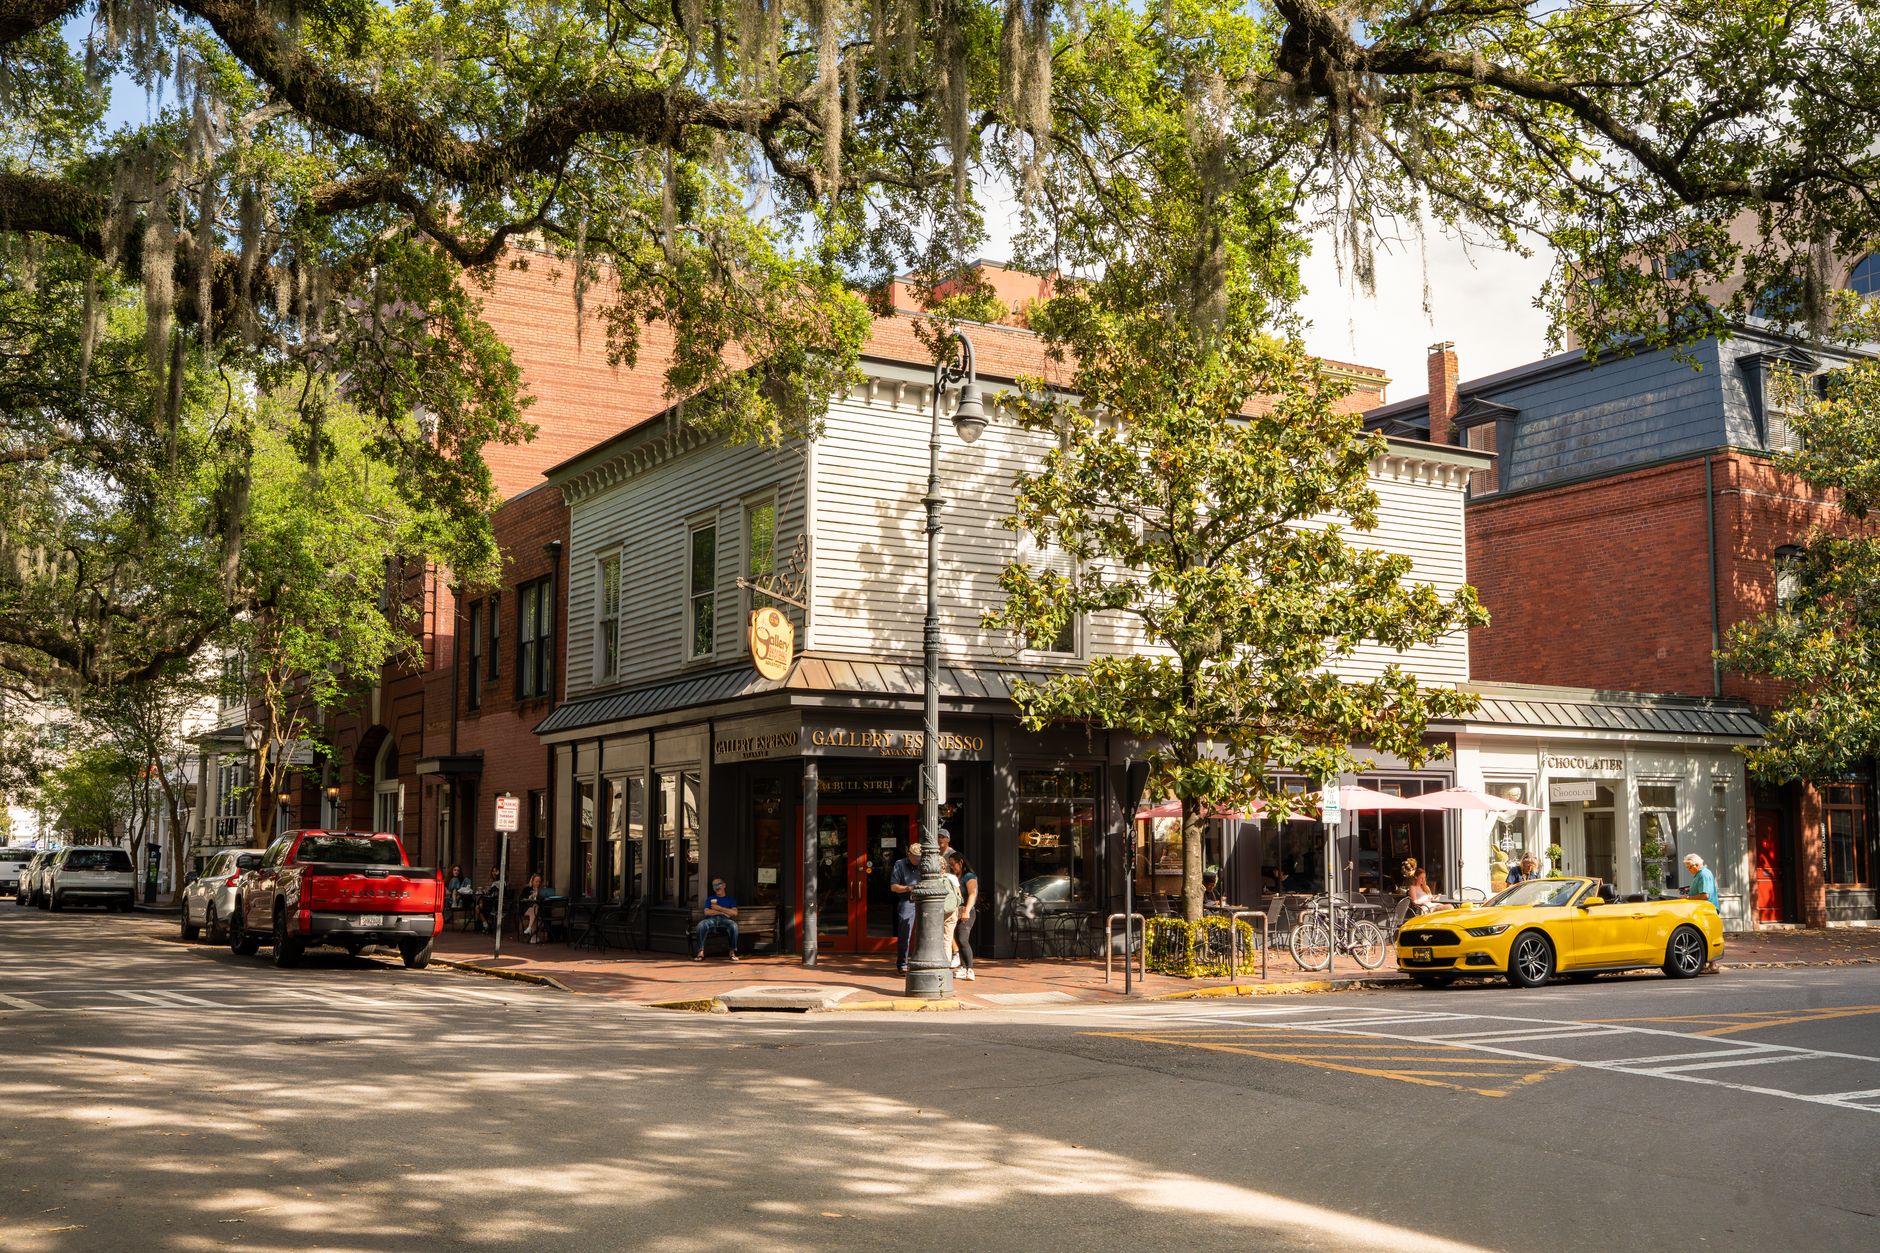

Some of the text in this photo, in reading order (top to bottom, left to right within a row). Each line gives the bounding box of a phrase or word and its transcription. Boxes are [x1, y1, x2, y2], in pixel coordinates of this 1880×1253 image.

[715, 737, 754, 755] GALLERY
[755, 731, 798, 750] ESPRESSO
[811, 730, 984, 752] GALLERY ESRESSO
[1547, 755, 1623, 771] CHOCOLATIER
[833, 780, 861, 790] BULL
[1552, 786, 1593, 798] CHOCOLATE
[339, 888, 411, 899] TUNDRA
